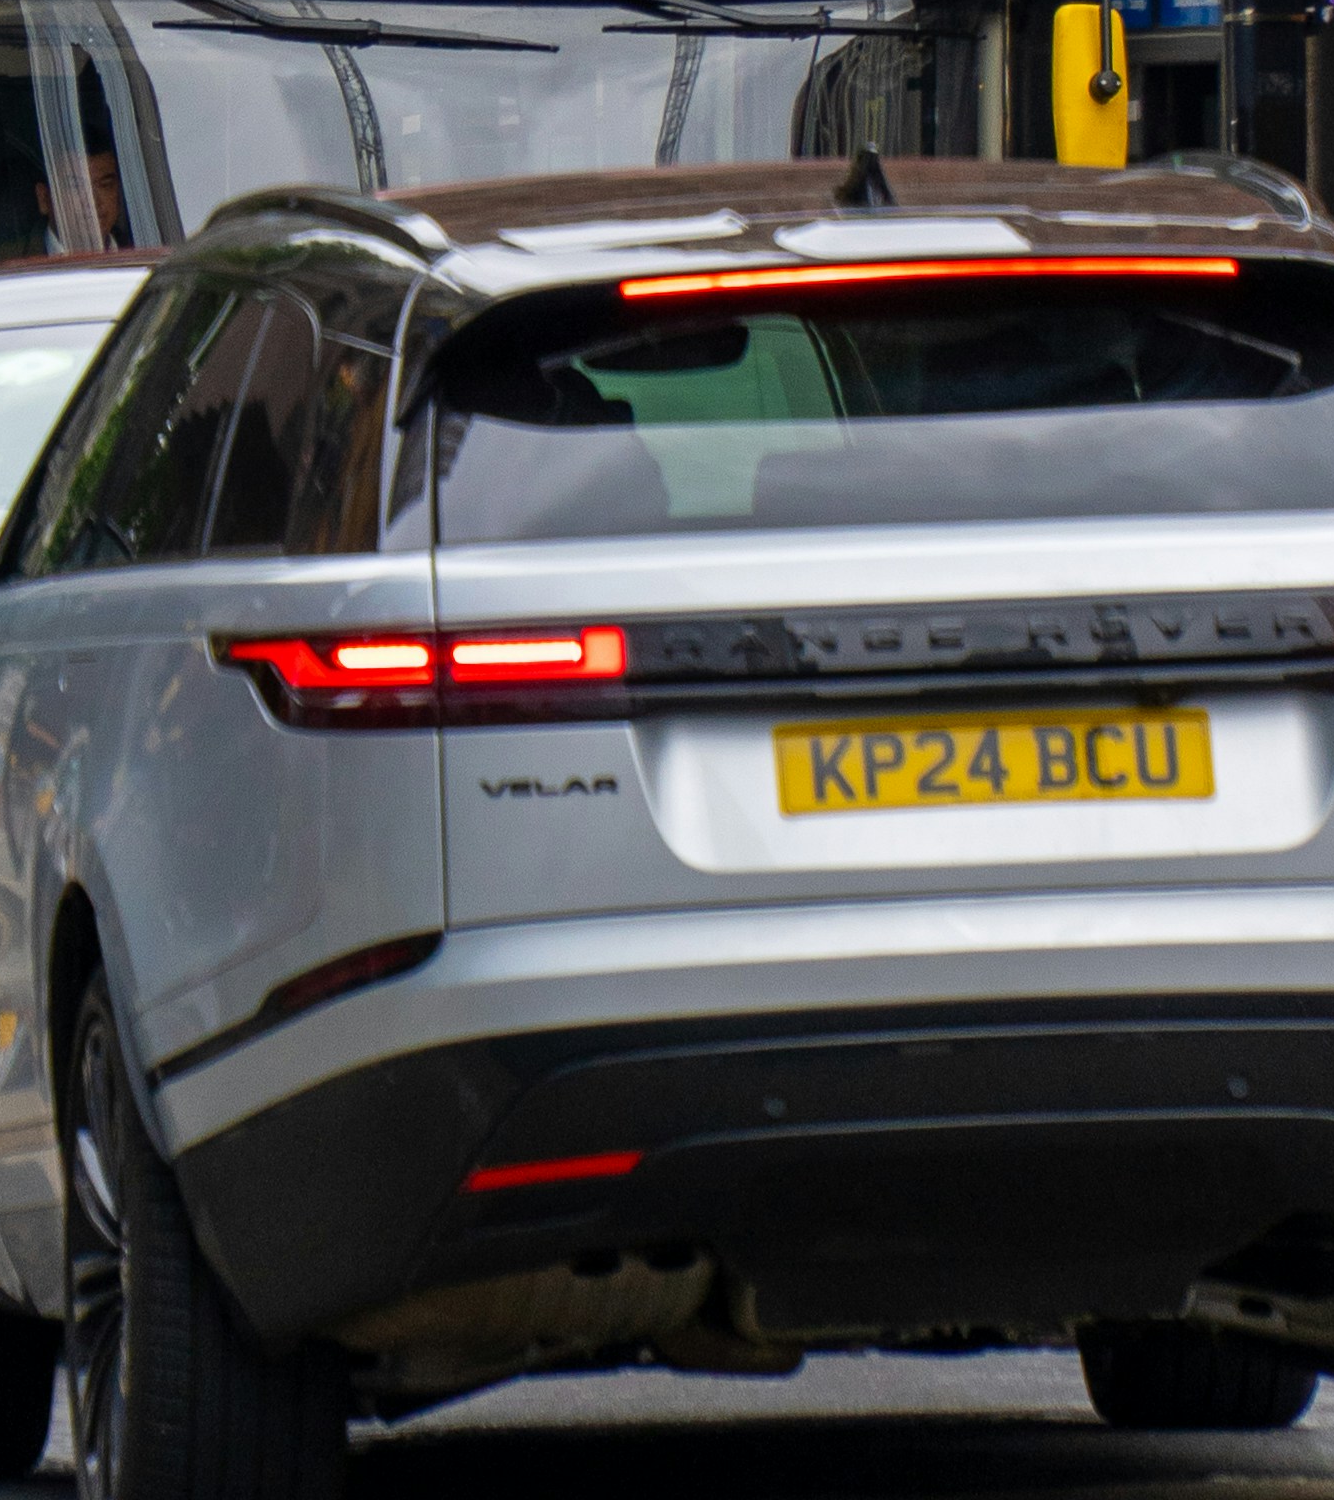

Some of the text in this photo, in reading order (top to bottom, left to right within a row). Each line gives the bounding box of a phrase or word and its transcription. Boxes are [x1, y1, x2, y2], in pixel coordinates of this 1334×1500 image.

[664, 606, 1315, 661] RANGE ROVER
[479, 773, 619, 799] VELAR
[809, 722, 1179, 804] KP24 BCU
